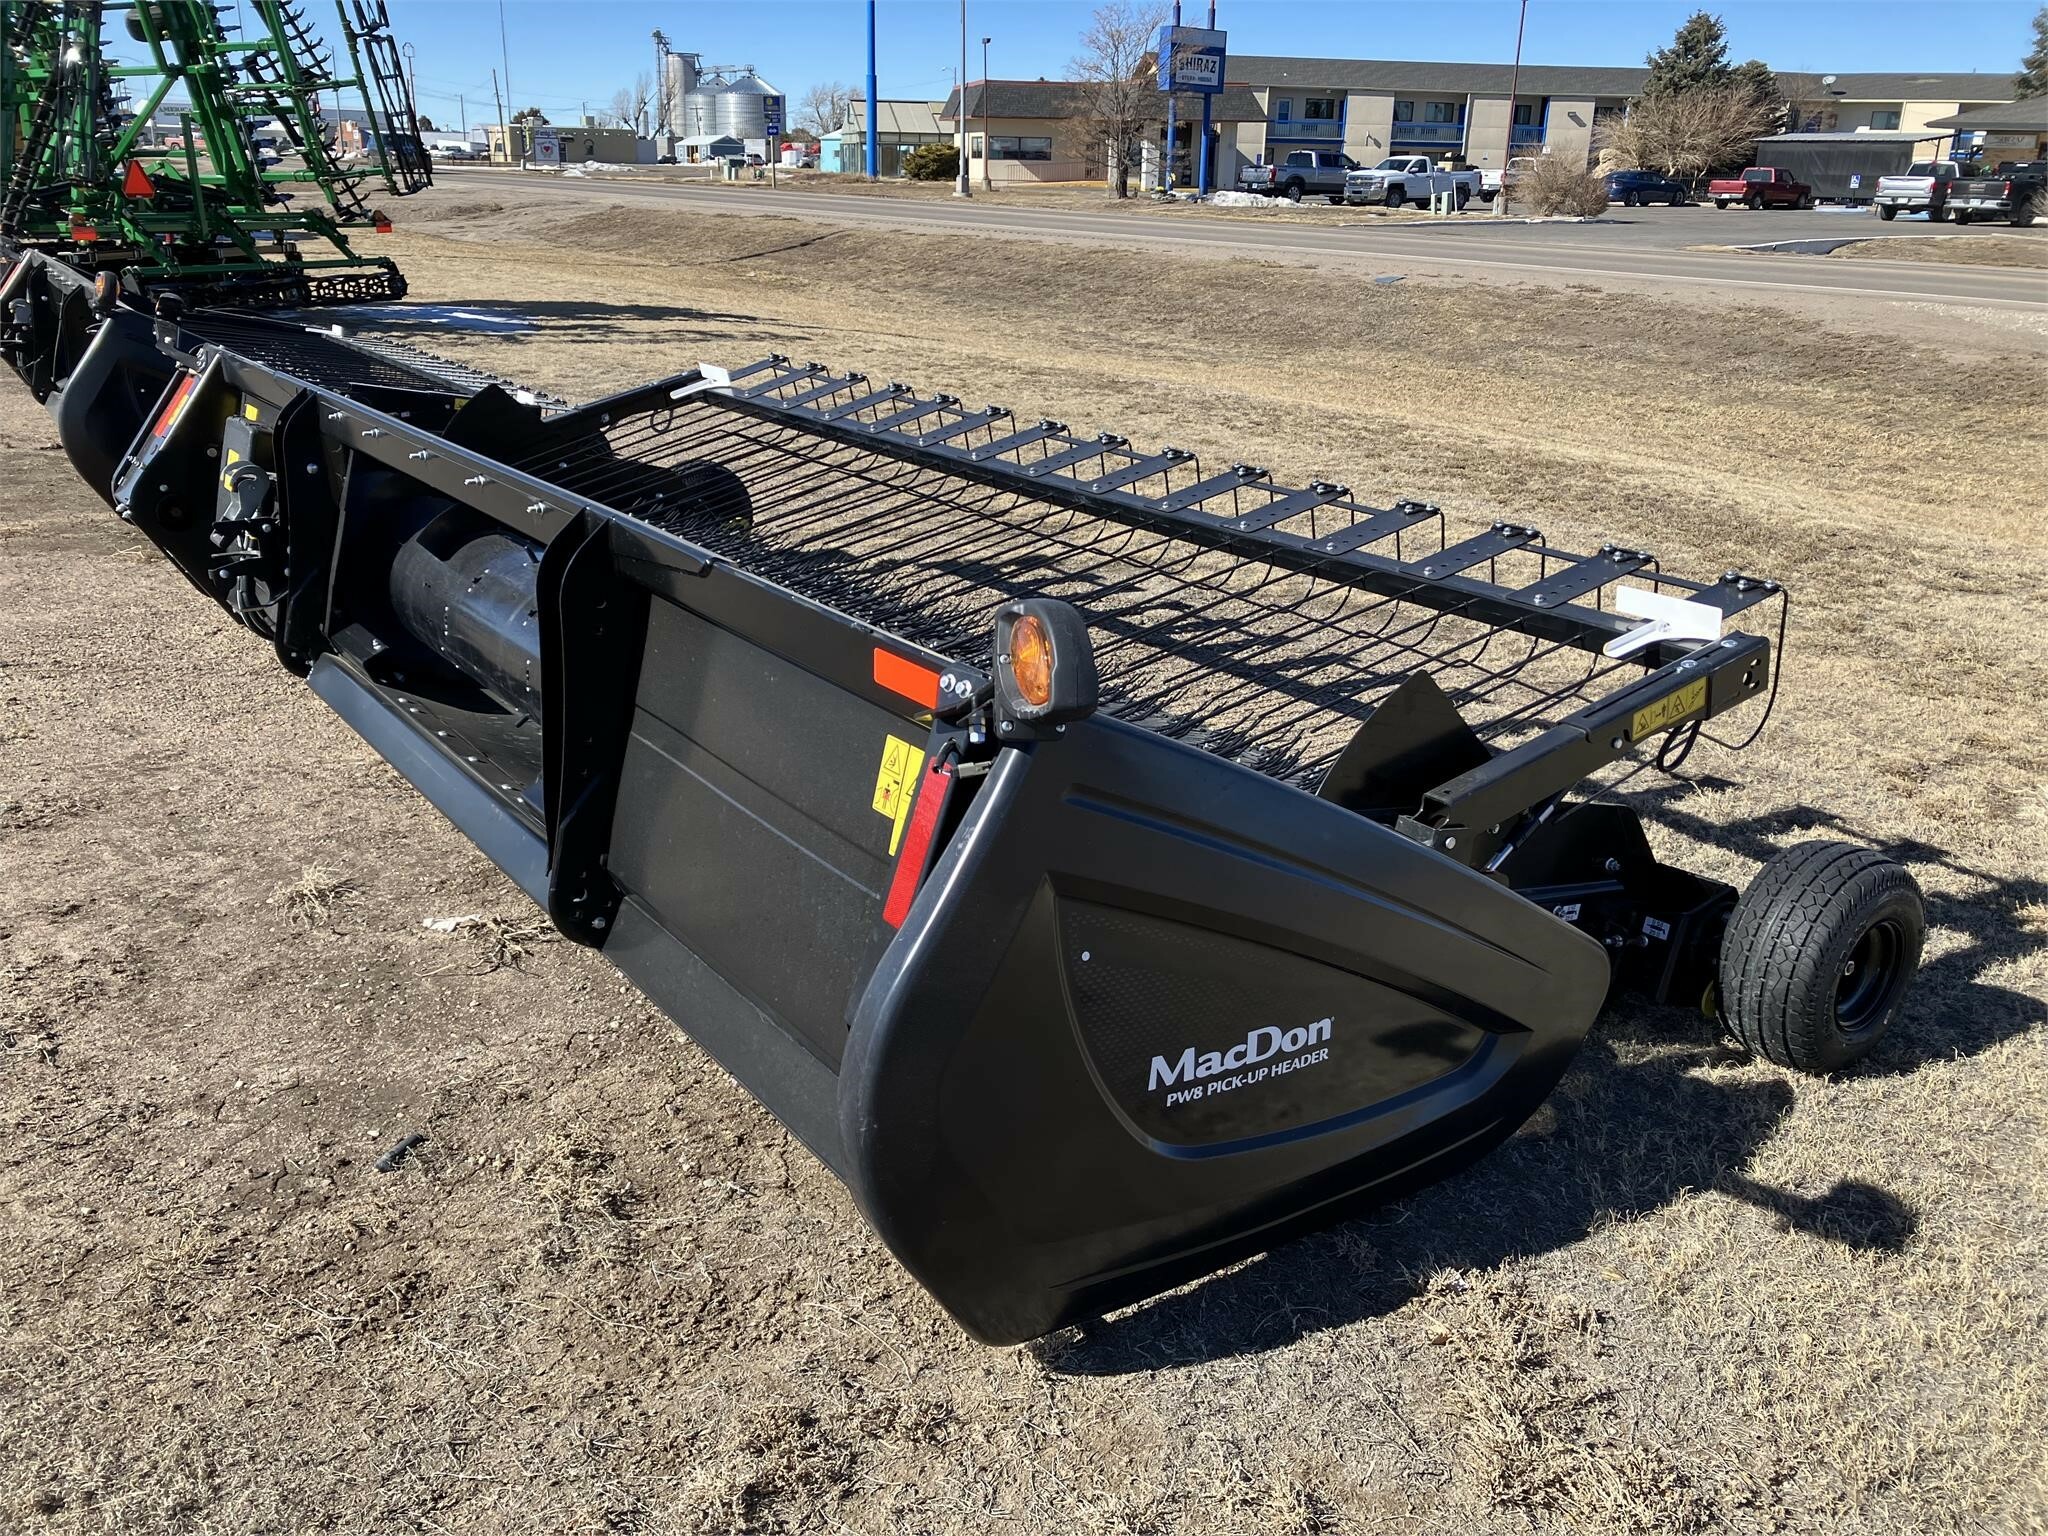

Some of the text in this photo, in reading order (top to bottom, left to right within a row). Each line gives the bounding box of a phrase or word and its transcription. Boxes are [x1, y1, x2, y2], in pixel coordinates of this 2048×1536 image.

[1178, 56, 1218, 74] SHIRAZ
[1147, 1017, 1333, 1091] MacDon
[1166, 1048, 1329, 1107] PW8 PICK-UP HEADER
